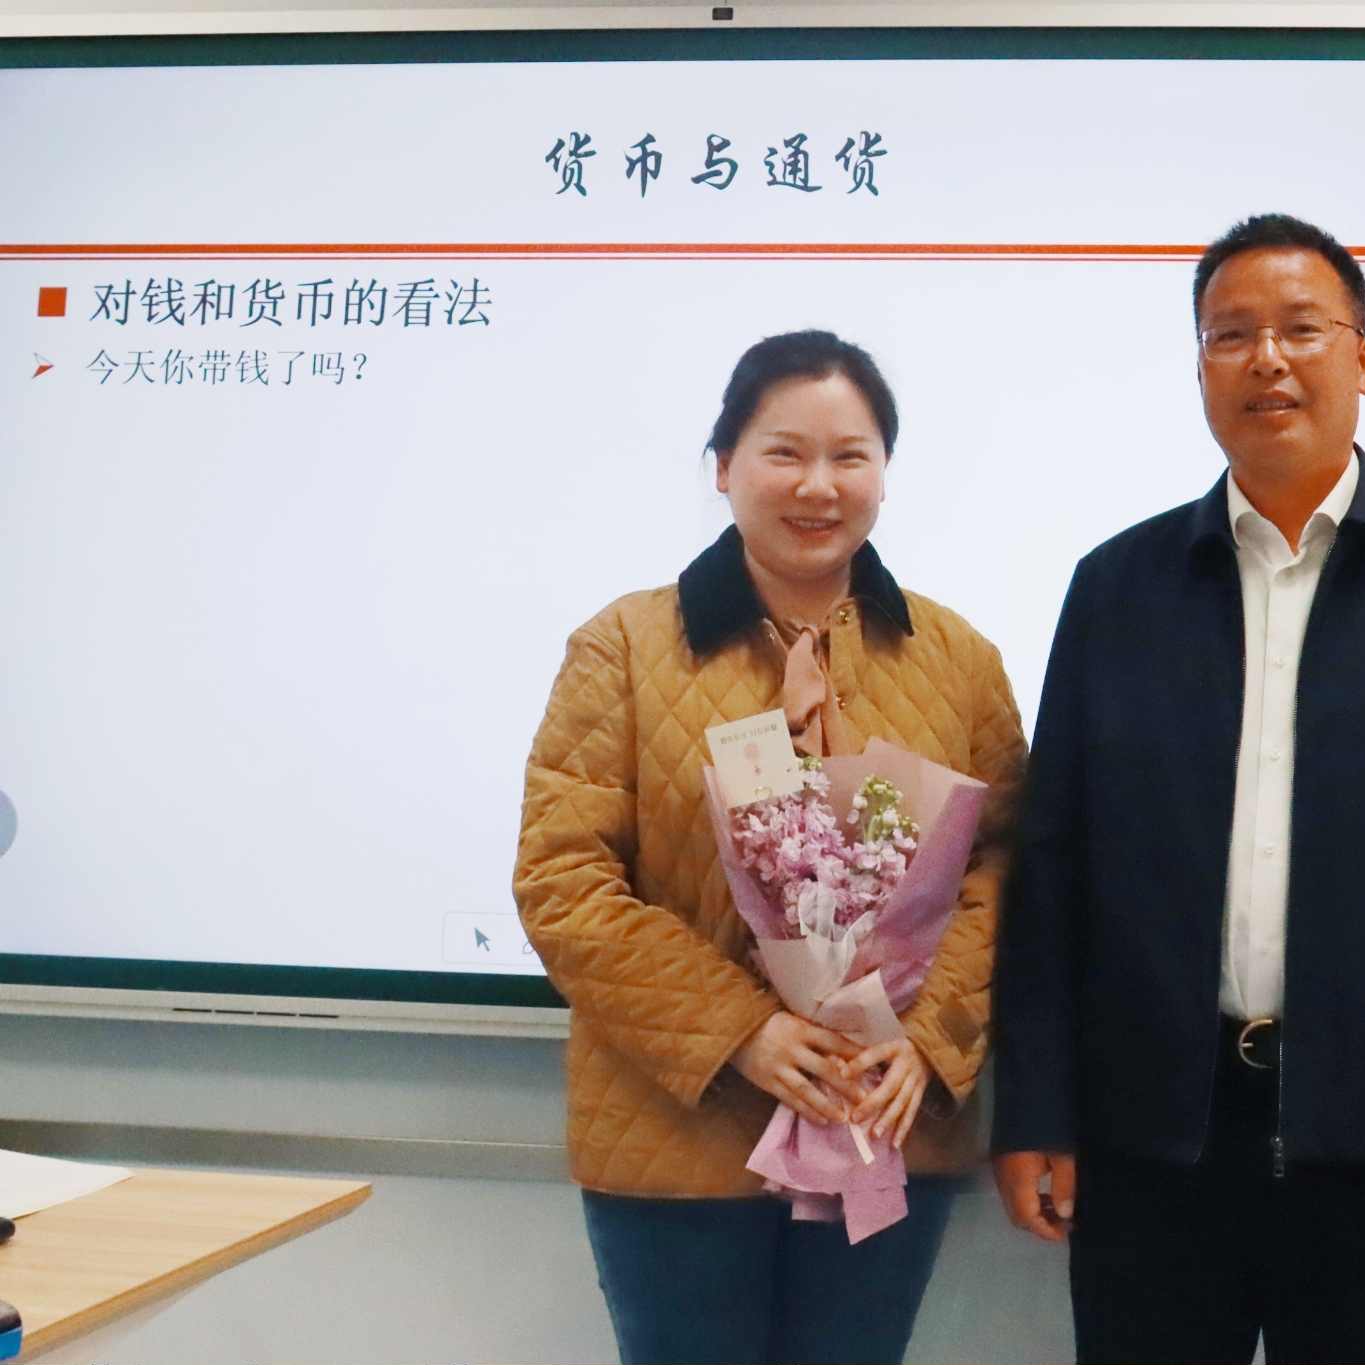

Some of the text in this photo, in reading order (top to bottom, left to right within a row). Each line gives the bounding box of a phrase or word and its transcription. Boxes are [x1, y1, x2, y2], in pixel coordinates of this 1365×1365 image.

[545, 130, 890, 198] 货币与通货
[91, 277, 493, 328] 对钱和货币的看法
